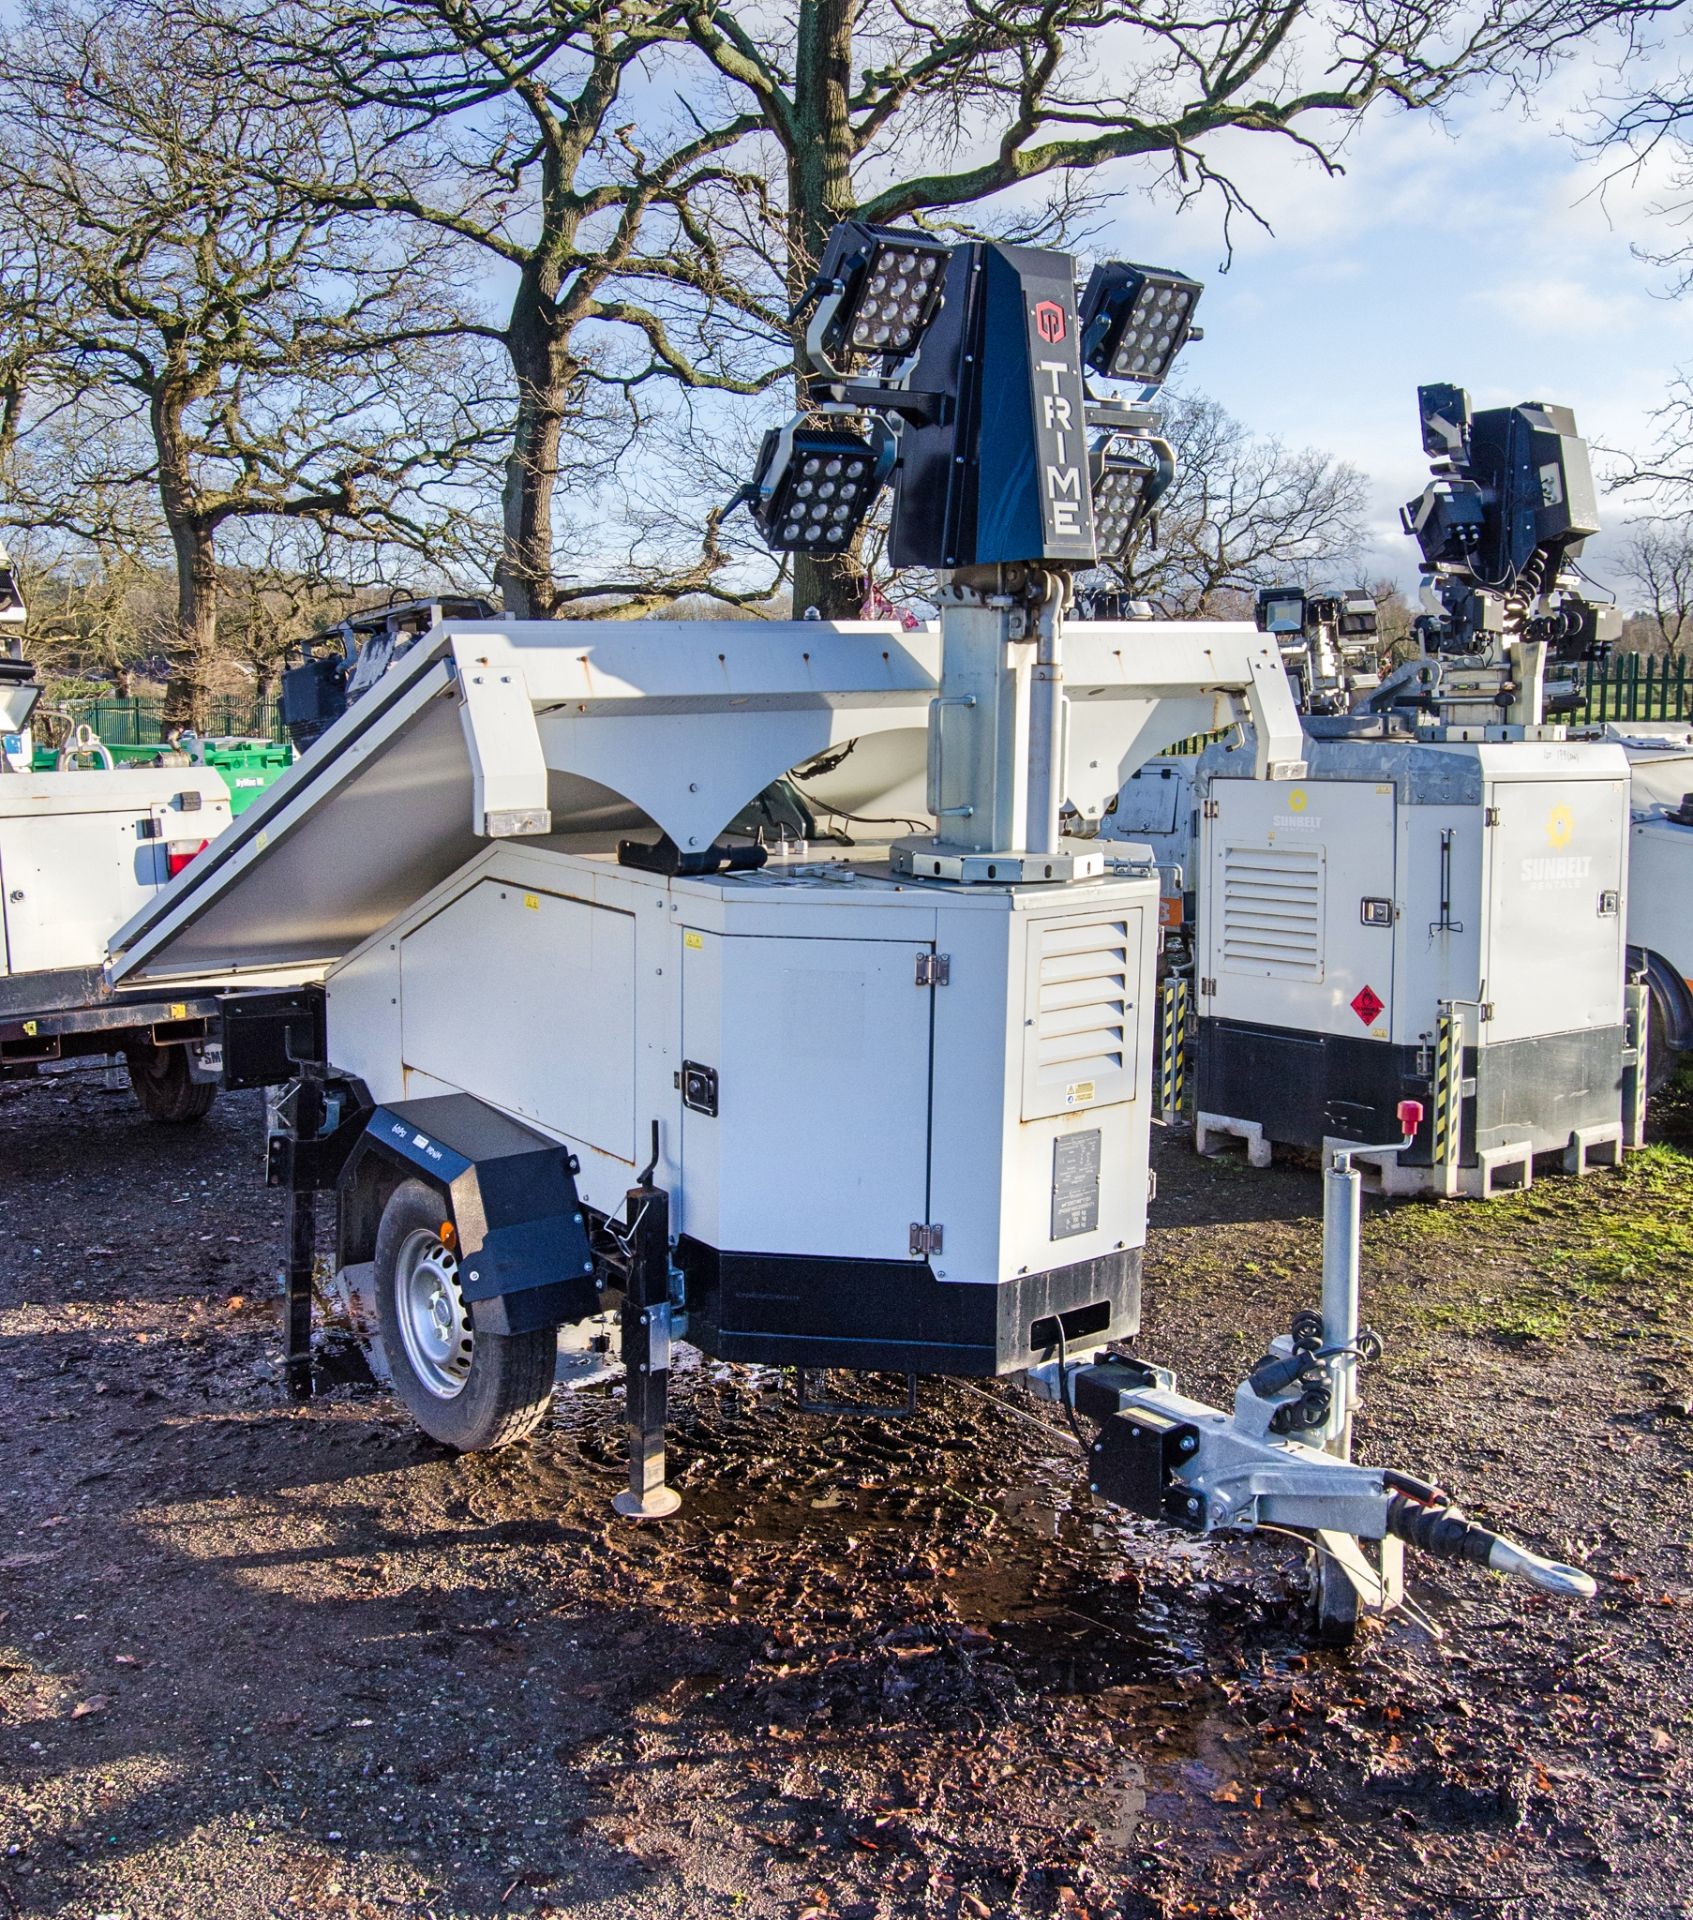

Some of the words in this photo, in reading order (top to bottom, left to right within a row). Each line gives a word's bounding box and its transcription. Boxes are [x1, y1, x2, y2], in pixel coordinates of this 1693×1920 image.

[1040, 360, 1082, 535] TRIME
[1273, 815, 1322, 828] SUNBELT
[1521, 856, 1592, 881] SUNBELT
[204, 1050, 223, 1065] SM
